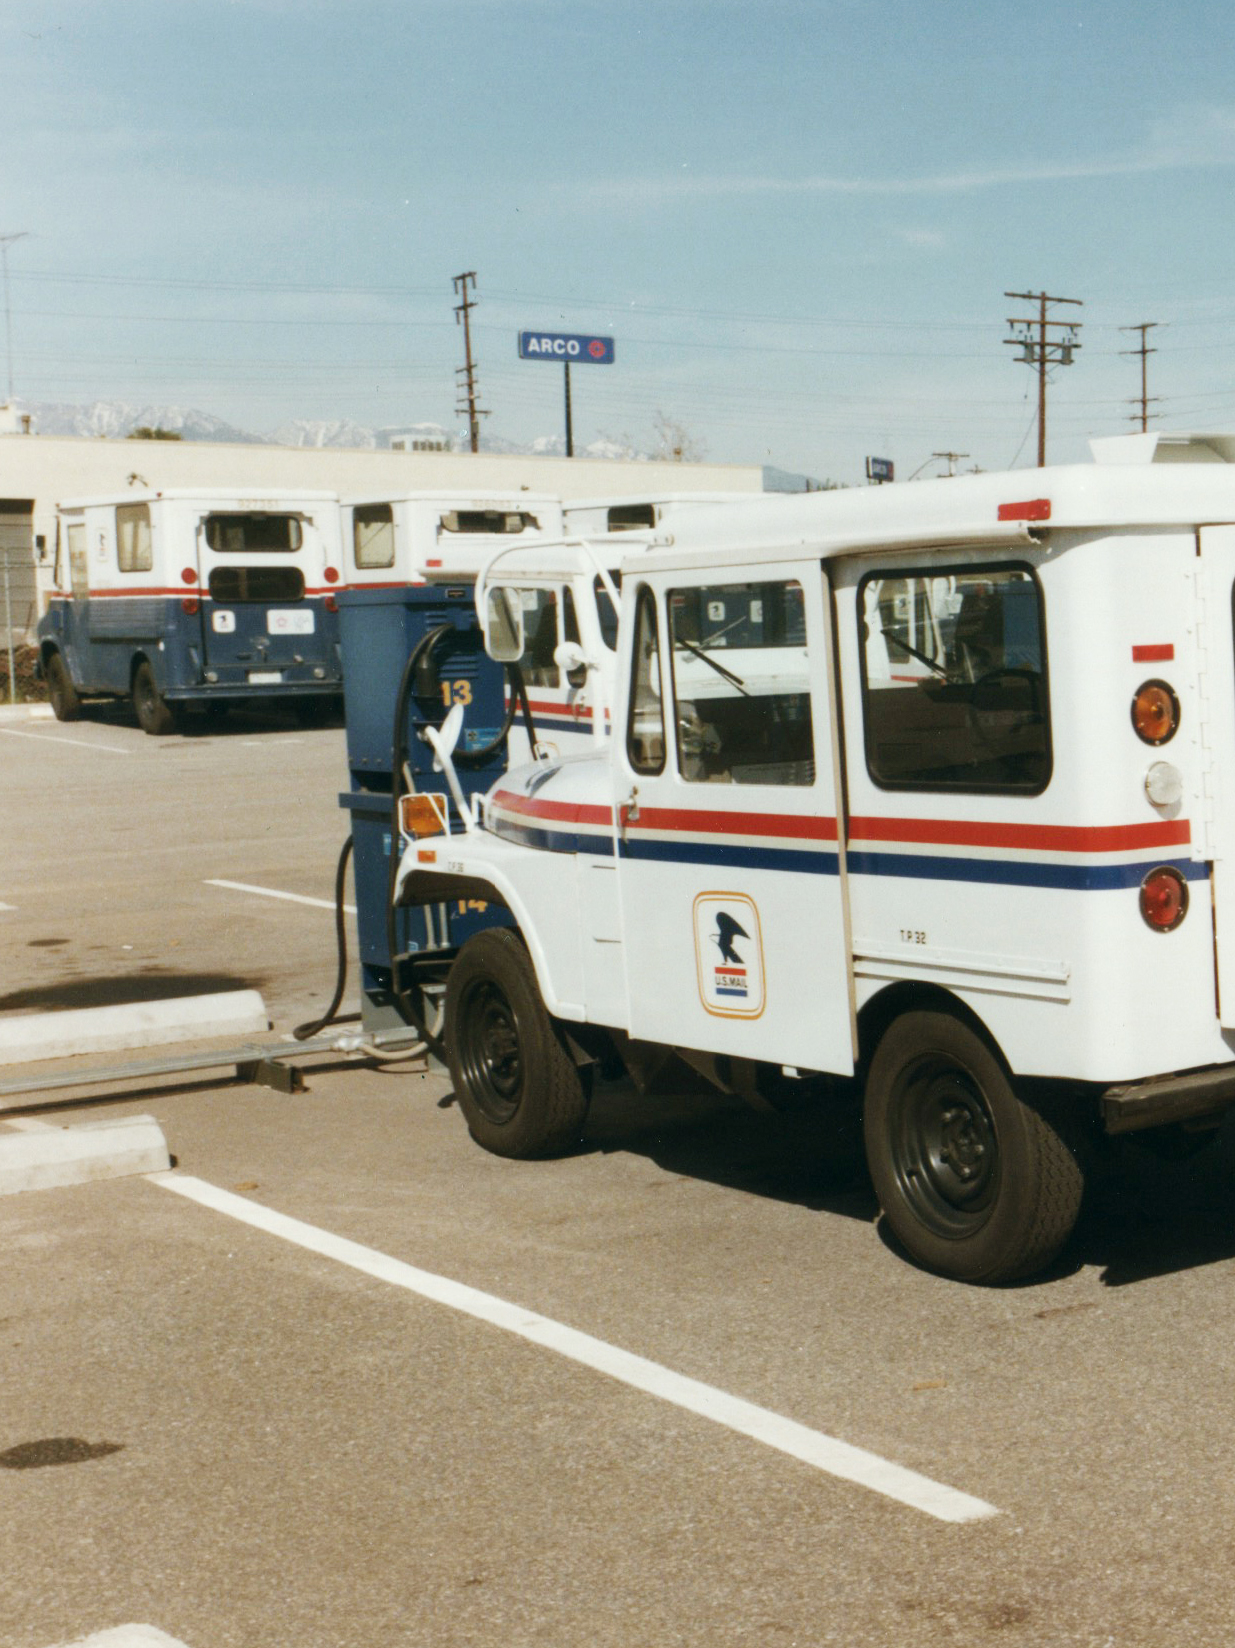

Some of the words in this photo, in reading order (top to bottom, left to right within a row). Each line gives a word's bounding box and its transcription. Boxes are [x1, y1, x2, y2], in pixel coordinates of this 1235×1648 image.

[528, 338, 580, 355] ARCO
[441, 679, 472, 706] 13
[915, 931, 926, 945] 32
